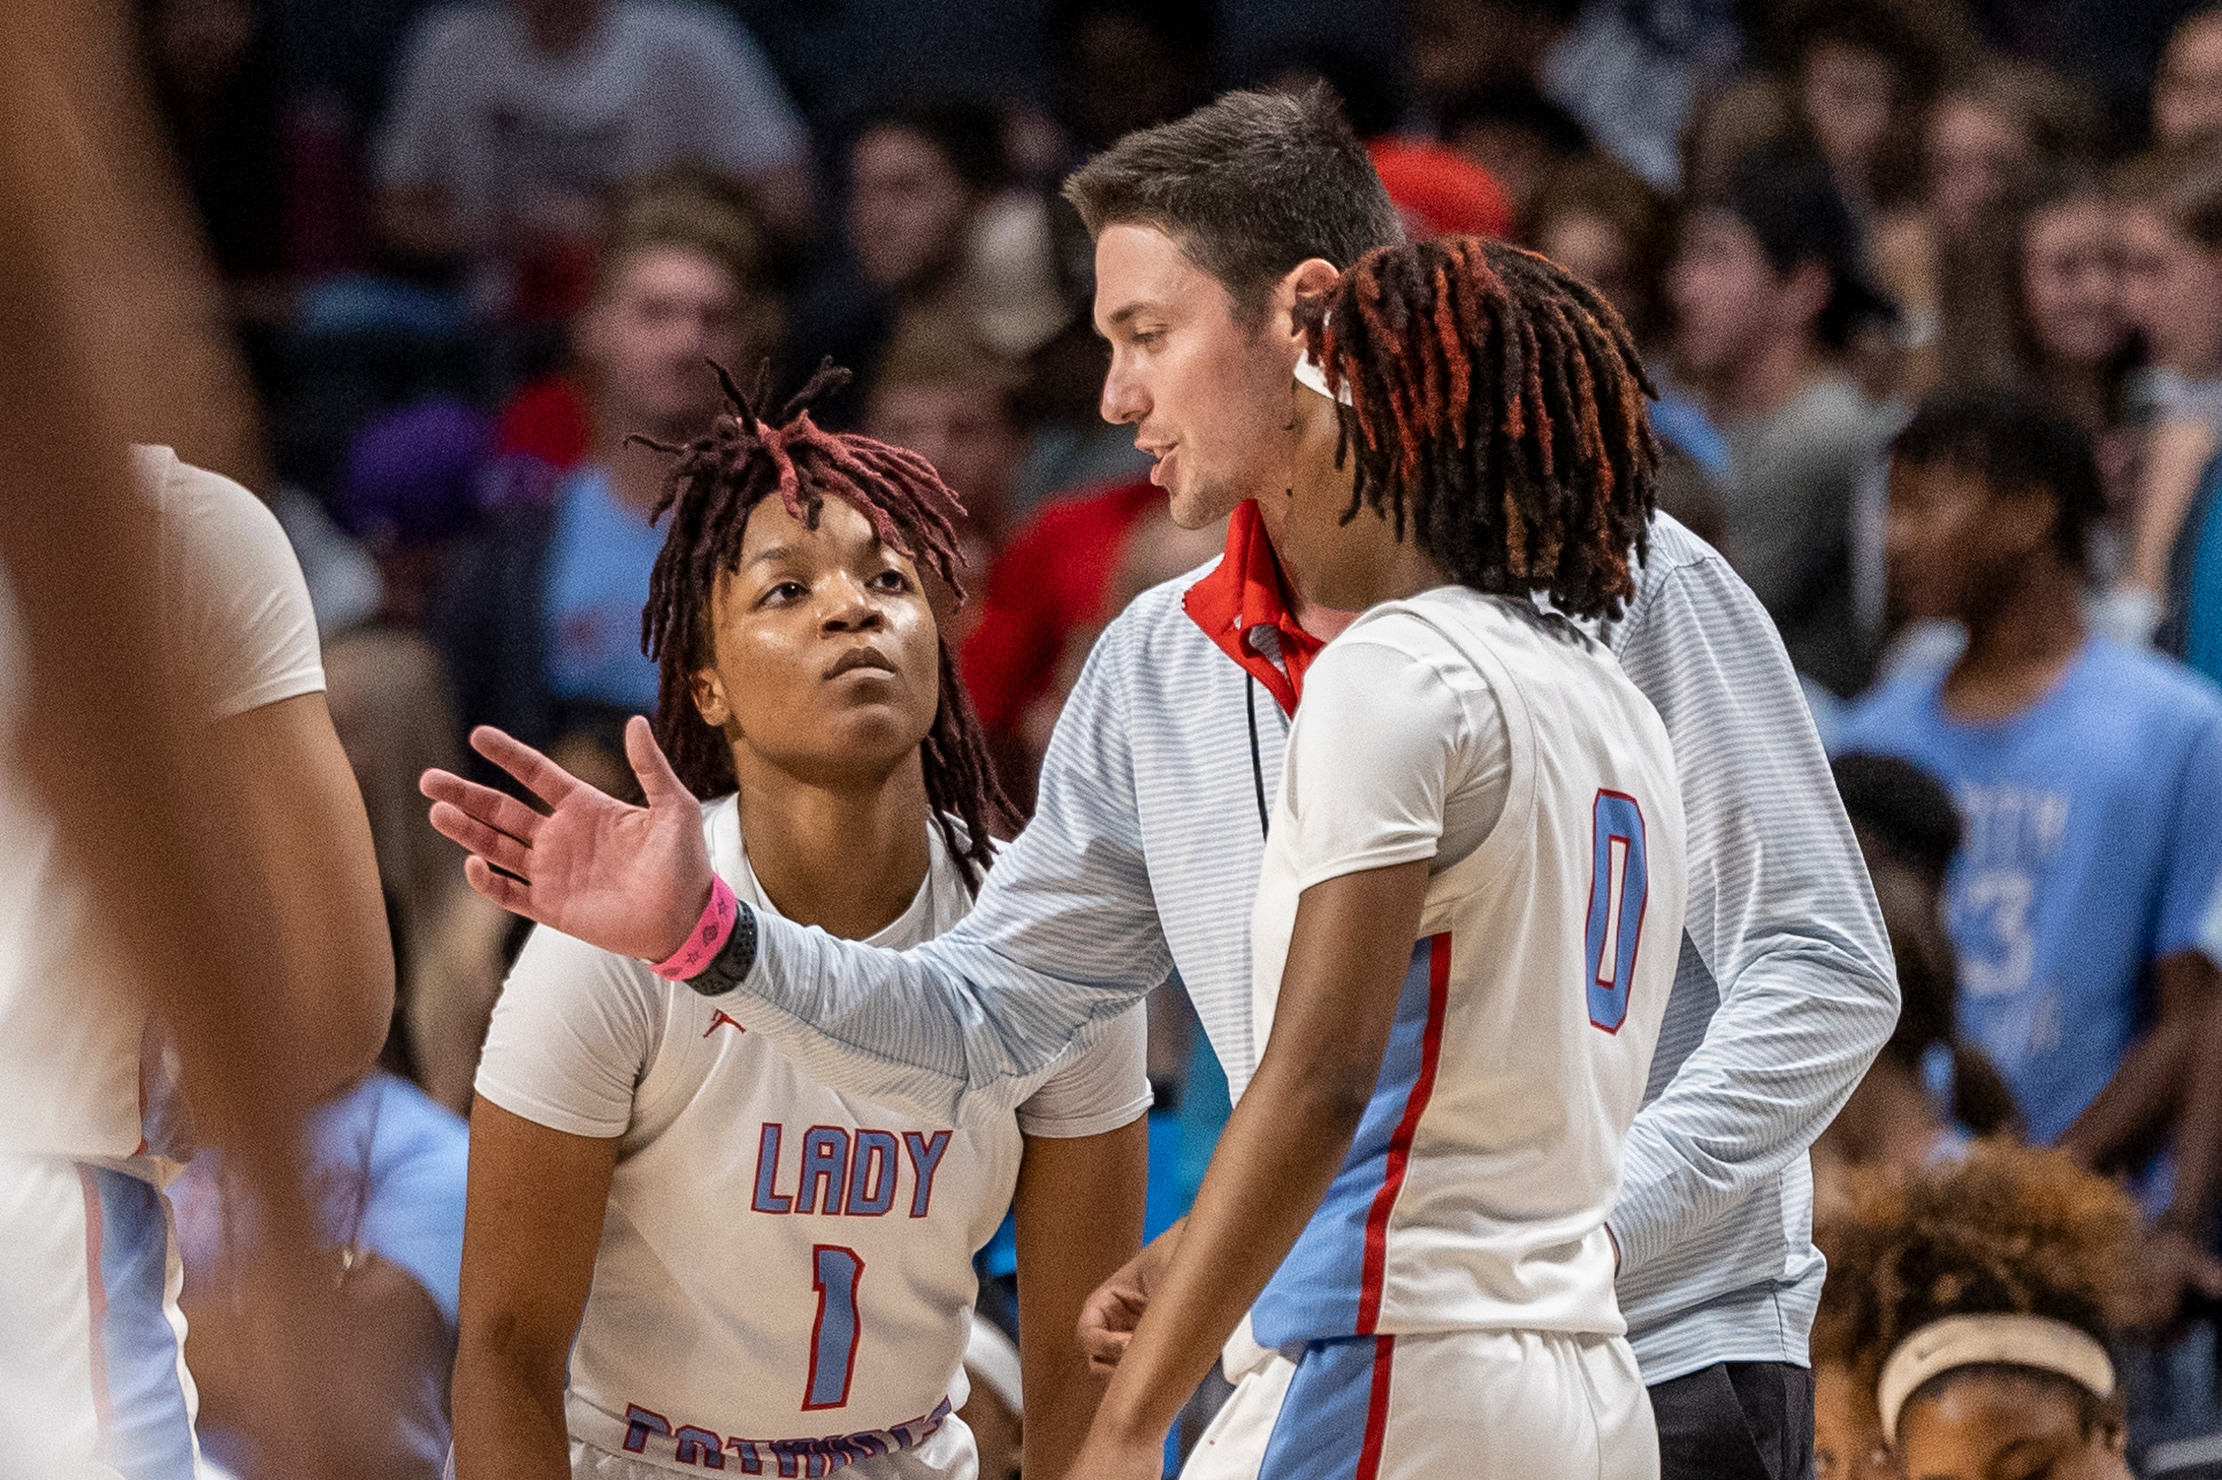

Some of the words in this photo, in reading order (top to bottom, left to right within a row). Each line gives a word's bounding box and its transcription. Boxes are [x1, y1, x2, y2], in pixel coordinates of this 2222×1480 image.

[1585, 788, 1648, 1035] 0
[751, 1122, 953, 1218] LADY
[801, 1244, 866, 1411] 1
